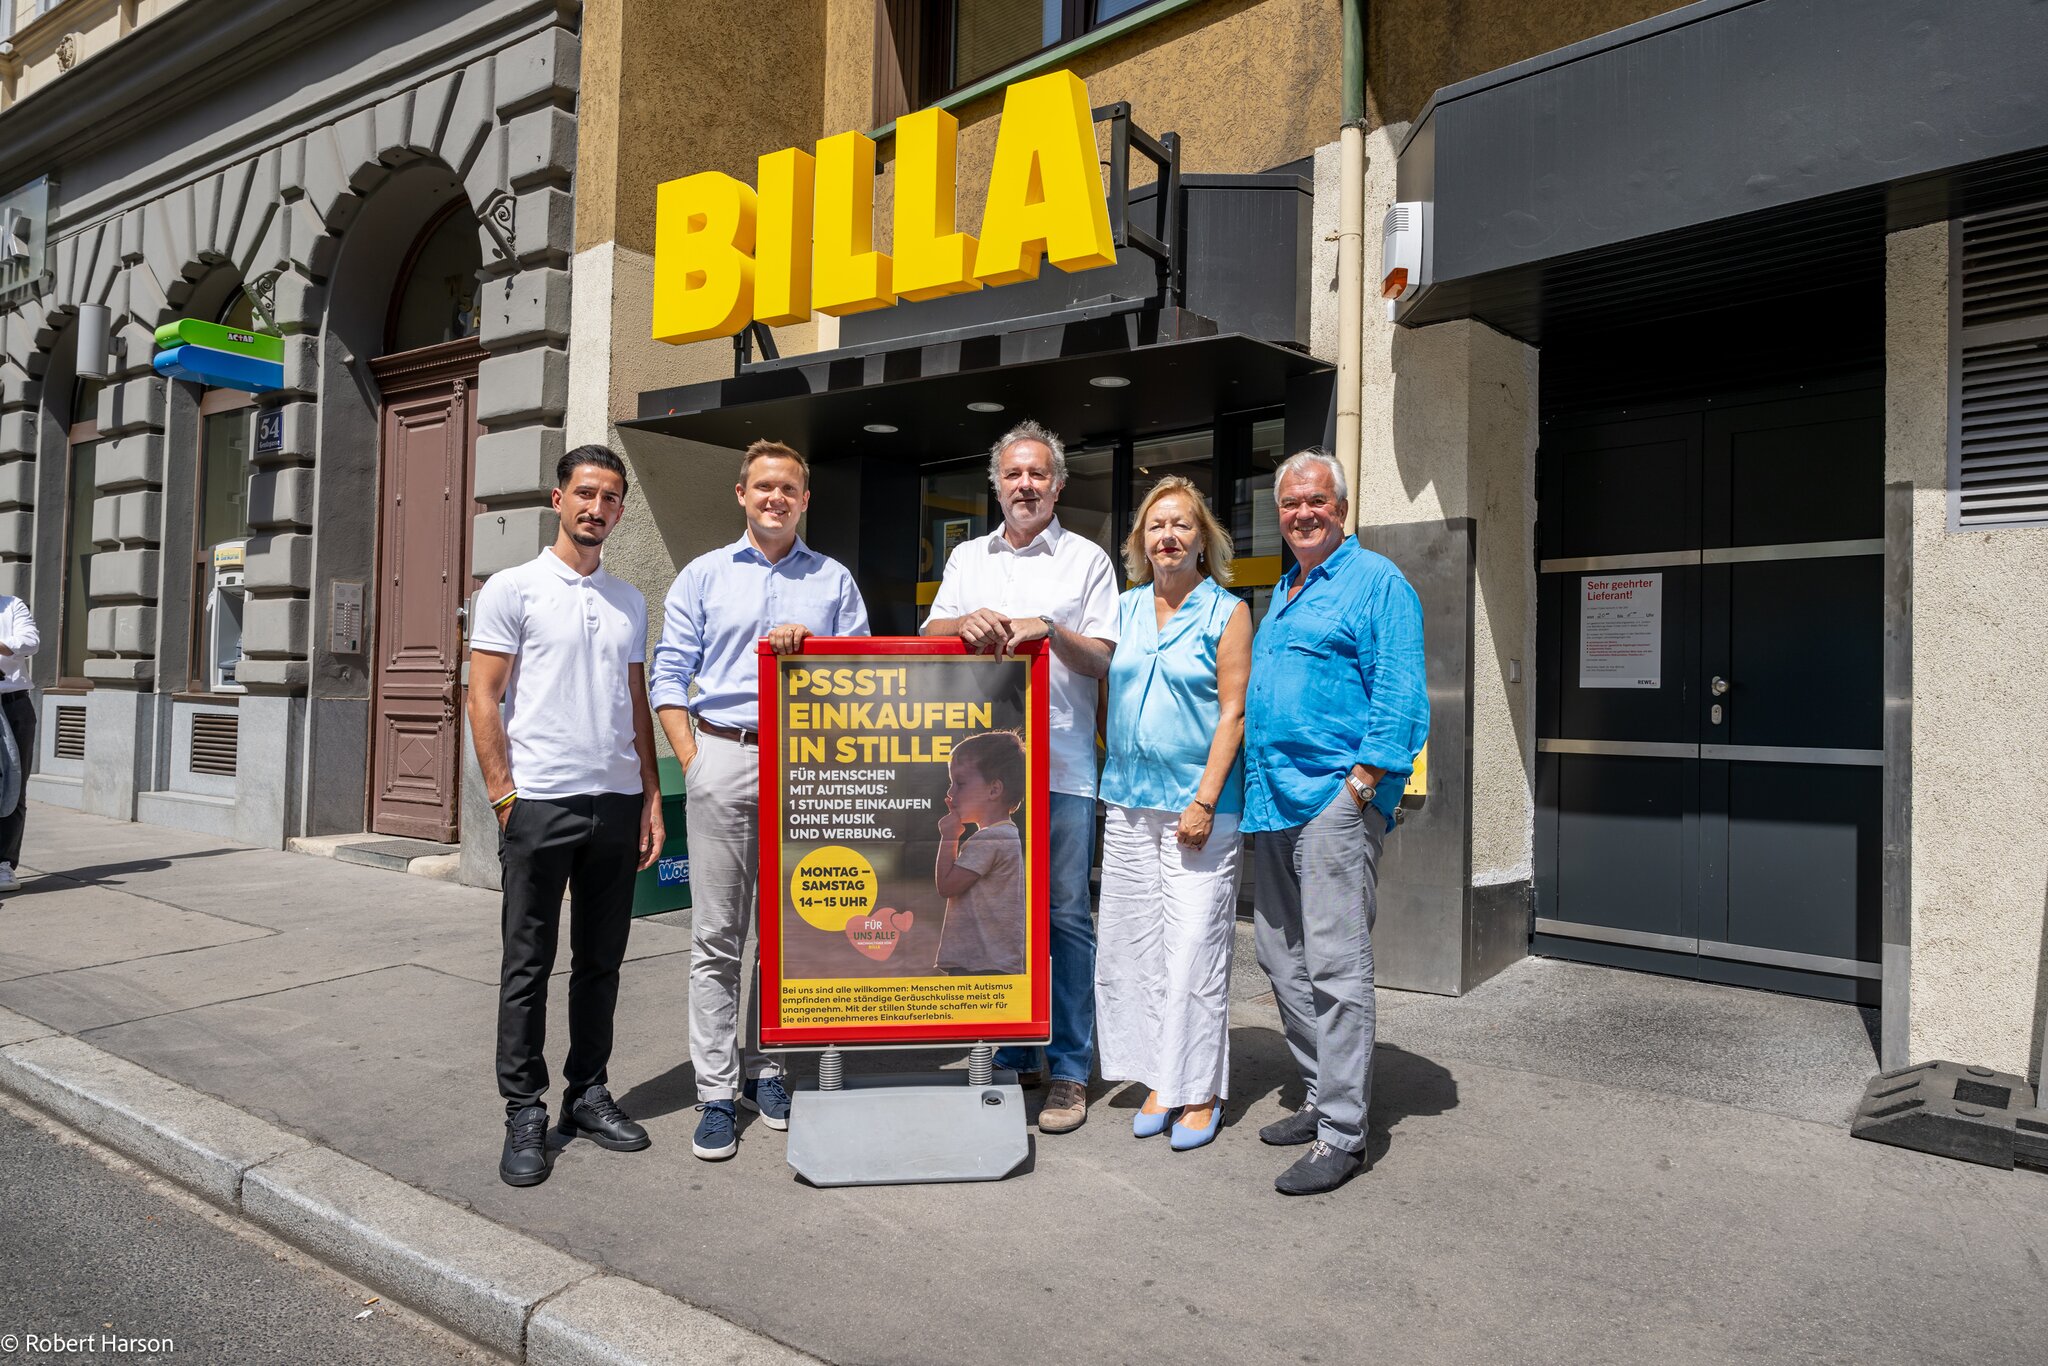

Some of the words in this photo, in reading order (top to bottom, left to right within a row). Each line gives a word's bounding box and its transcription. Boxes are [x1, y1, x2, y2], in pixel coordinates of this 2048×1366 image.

[652, 69, 1117, 345] BILLA
[260, 416, 280, 440] 54
[1587, 581, 1609, 590] Sehr
[1611, 579, 1653, 590] geehrter
[1587, 591, 1633, 601] Lieferant!
[789, 668, 907, 697] PSSST!
[789, 702, 992, 730] EINKAUFEN
[789, 736, 826, 764] IN
[834, 735, 952, 764] STILLE
[789, 767, 816, 781] FÜR
[818, 769, 896, 781] MENSCHEN
[789, 784, 815, 796] MIT
[817, 784, 888, 796] AUTISMUS:
[789, 800, 796, 811] 1
[798, 799, 852, 811] STUNDE
[855, 798, 932, 811] EINKAUFEN
[789, 813, 829, 825] OHNE
[832, 813, 876, 825] MUSIK
[789, 828, 820, 840] UND
[822, 827, 896, 840] WERBUNG.
[800, 866, 859, 878] MONTAG
[801, 880, 865, 891] SAMSTAG
[839, 896, 868, 907] UHR
[864, 919, 882, 930] FÜR
[853, 931, 872, 940] UNS
[875, 931, 896, 940] ALLE
[782, 986, 796, 994] Bei
[815, 986, 834, 994] sind
[853, 985, 909, 993] willkommen:
[911, 984, 955, 992] Menschen
[974, 983, 1013, 991] Autismus
[782, 996, 830, 1005] empfinden
[853, 995, 892, 1004] ständige
[894, 993, 964, 1002] Geräuschkulisse
[966, 992, 991, 1000] meist
[992, 992, 1005, 1000] als
[782, 1006, 843, 1015] unangenehm.
[845, 1005, 860, 1013] Mit
[861, 1004, 877, 1012] der
[907, 1003, 937, 1011] Stunde
[939, 1002, 978, 1010] schaffen
[995, 1001, 1008, 1009] für
[796, 1015, 810, 1023] ein
[812, 1014, 878, 1024] angenehmeres
[880, 1012, 954, 1021] Einkaufserlebnis.
